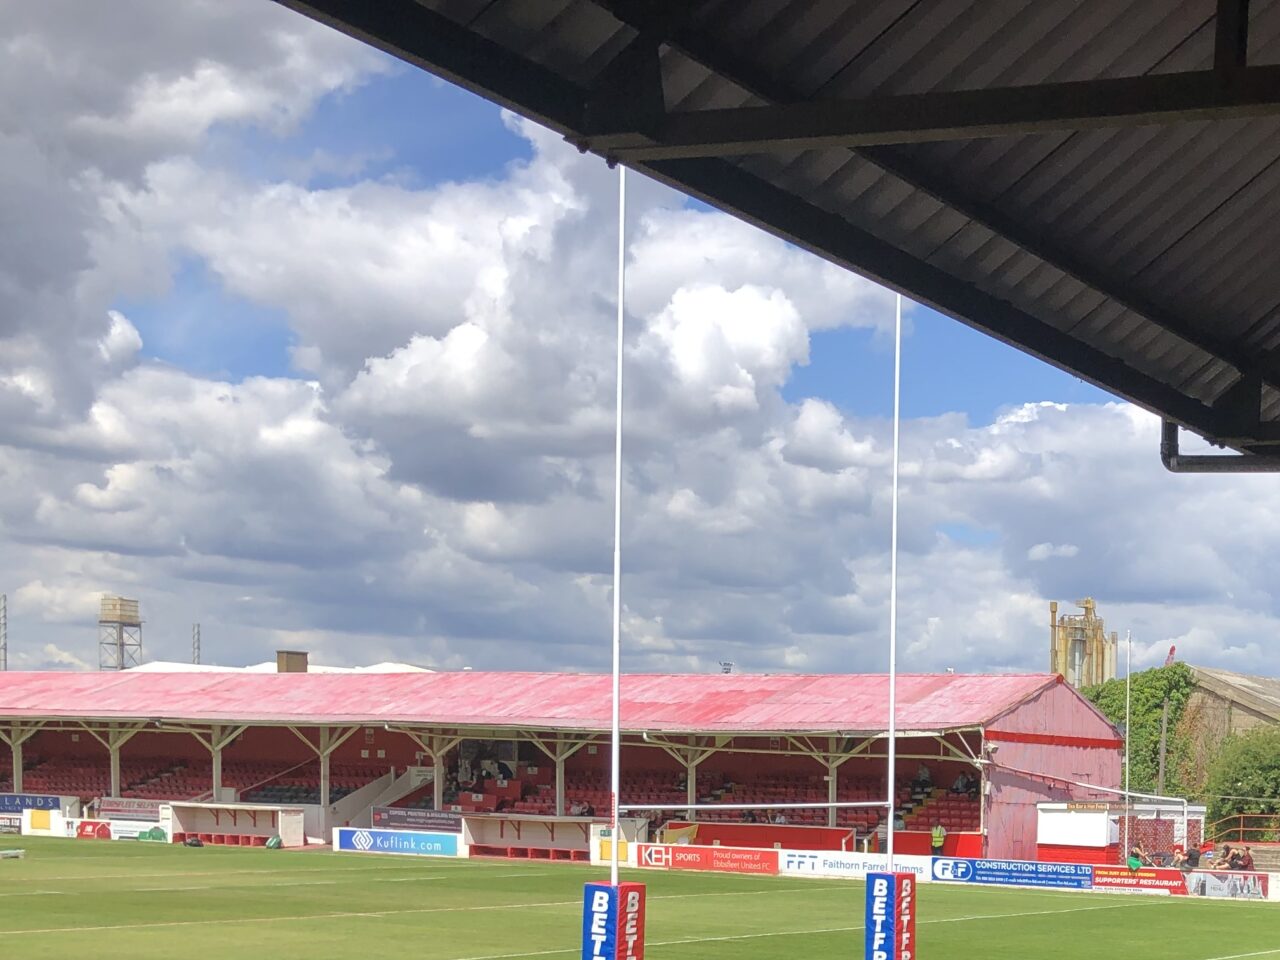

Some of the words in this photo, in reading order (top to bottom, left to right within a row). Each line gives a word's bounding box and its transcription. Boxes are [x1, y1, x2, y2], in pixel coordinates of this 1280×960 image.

[376, 835, 442, 851] Kuflink.com
[642, 846, 673, 867] KEH
[675, 853, 701, 863] SPORTS
[713, 850, 731, 859] Proud
[753, 853, 761, 861] of
[713, 859, 740, 869] Ebbsfleet
[741, 861, 761, 870] United
[762, 862, 771, 870] FC
[822, 859, 860, 870] Faithorn
[862, 862, 888, 872] Farrel
[894, 863, 924, 874] Timms
[975, 860, 1036, 872] CONSTRUCTION
[1037, 864, 1076, 874] SERVICES
[1077, 866, 1092, 875] LTD
[1095, 876, 1139, 885] SUPPORTERS'
[1139, 879, 1182, 887] RESTAURANT
